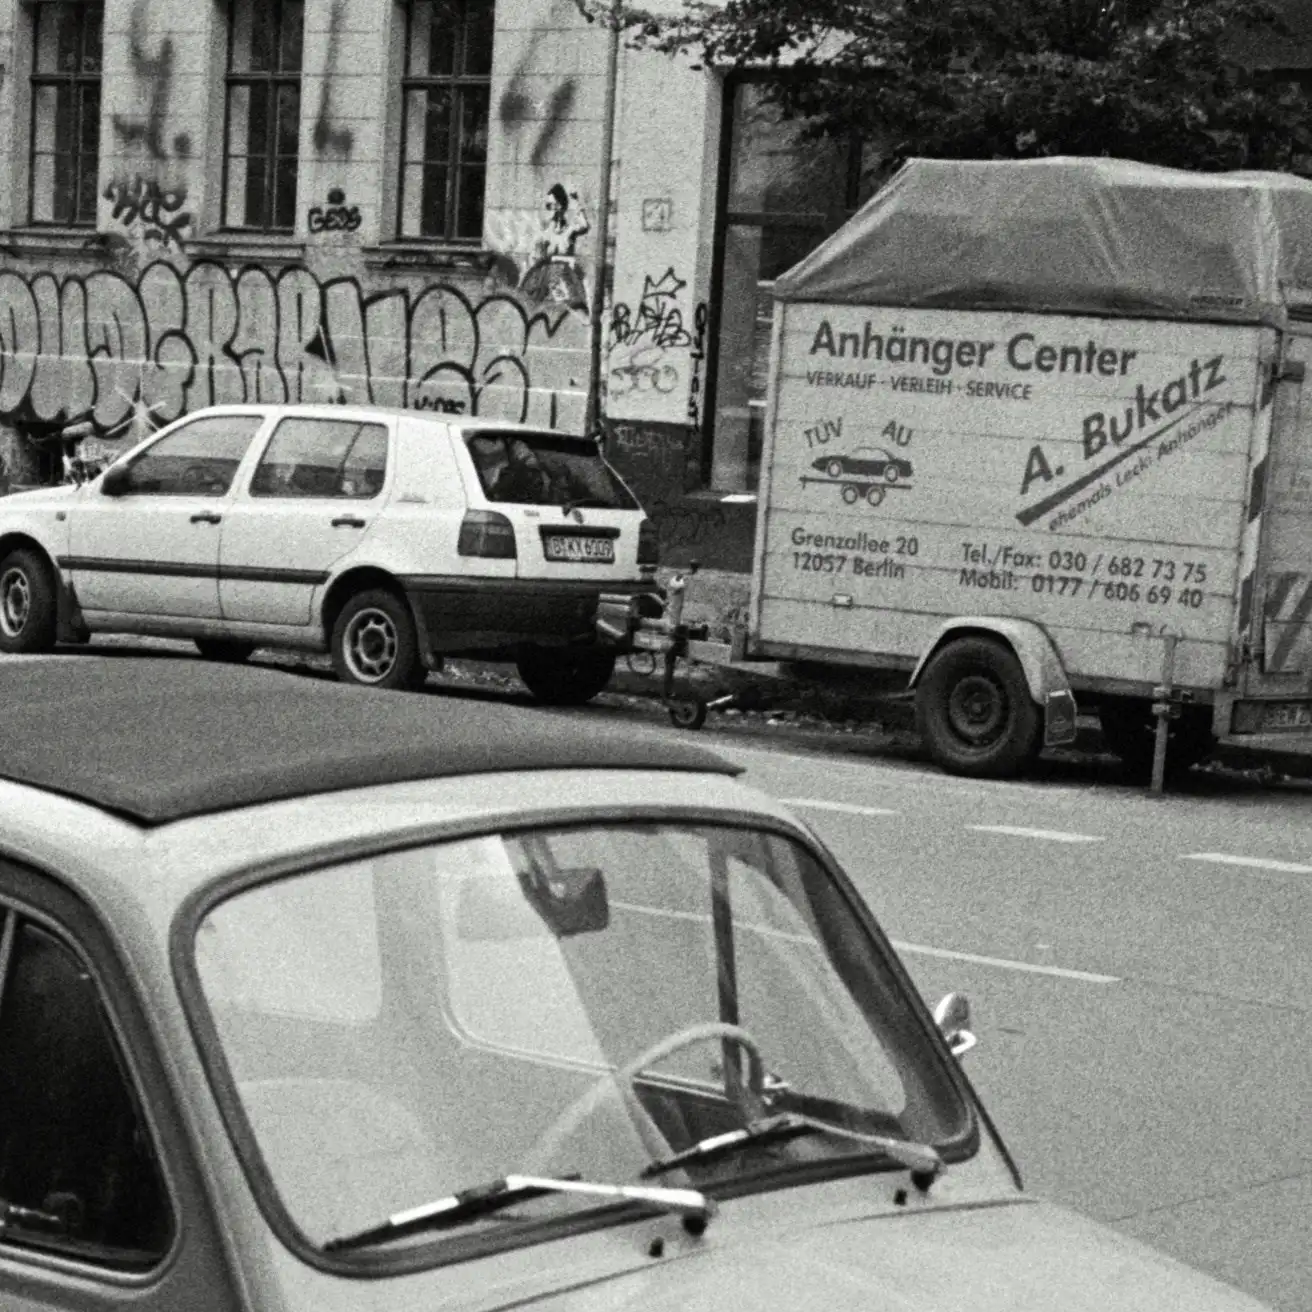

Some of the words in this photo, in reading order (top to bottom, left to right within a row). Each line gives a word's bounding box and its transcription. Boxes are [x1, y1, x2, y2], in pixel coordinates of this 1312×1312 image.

[809, 319, 995, 376] Anhänger
[1006, 332, 1138, 376] Center
[806, 370, 876, 390] VERKAUF
[890, 375, 953, 395] VERLEIH
[965, 381, 1033, 401] SERVICE
[803, 416, 842, 449] TÜV
[881, 419, 914, 447] AU
[1020, 445, 1065, 495] A.
[1082, 354, 1227, 460] Bukatz
[1049, 483, 1112, 532] ehemals
[791, 526, 890, 554] Grenzallee
[896, 536, 920, 557] 20
[792, 551, 847, 574] 12057
[852, 556, 906, 580] Berlin
[962, 543, 1043, 569] Tel./Fax:
[1048, 550, 1087, 572] 030
[1107, 556, 1145, 578] 682
[1152, 559, 1175, 580] 73
[1183, 562, 1208, 583] 75
[959, 568, 1019, 591] Mobil:
[1031, 574, 1083, 597] 0177
[1103, 581, 1141, 603] 606
[1147, 584, 1172, 605] 69
[1177, 587, 1204, 609] 40
